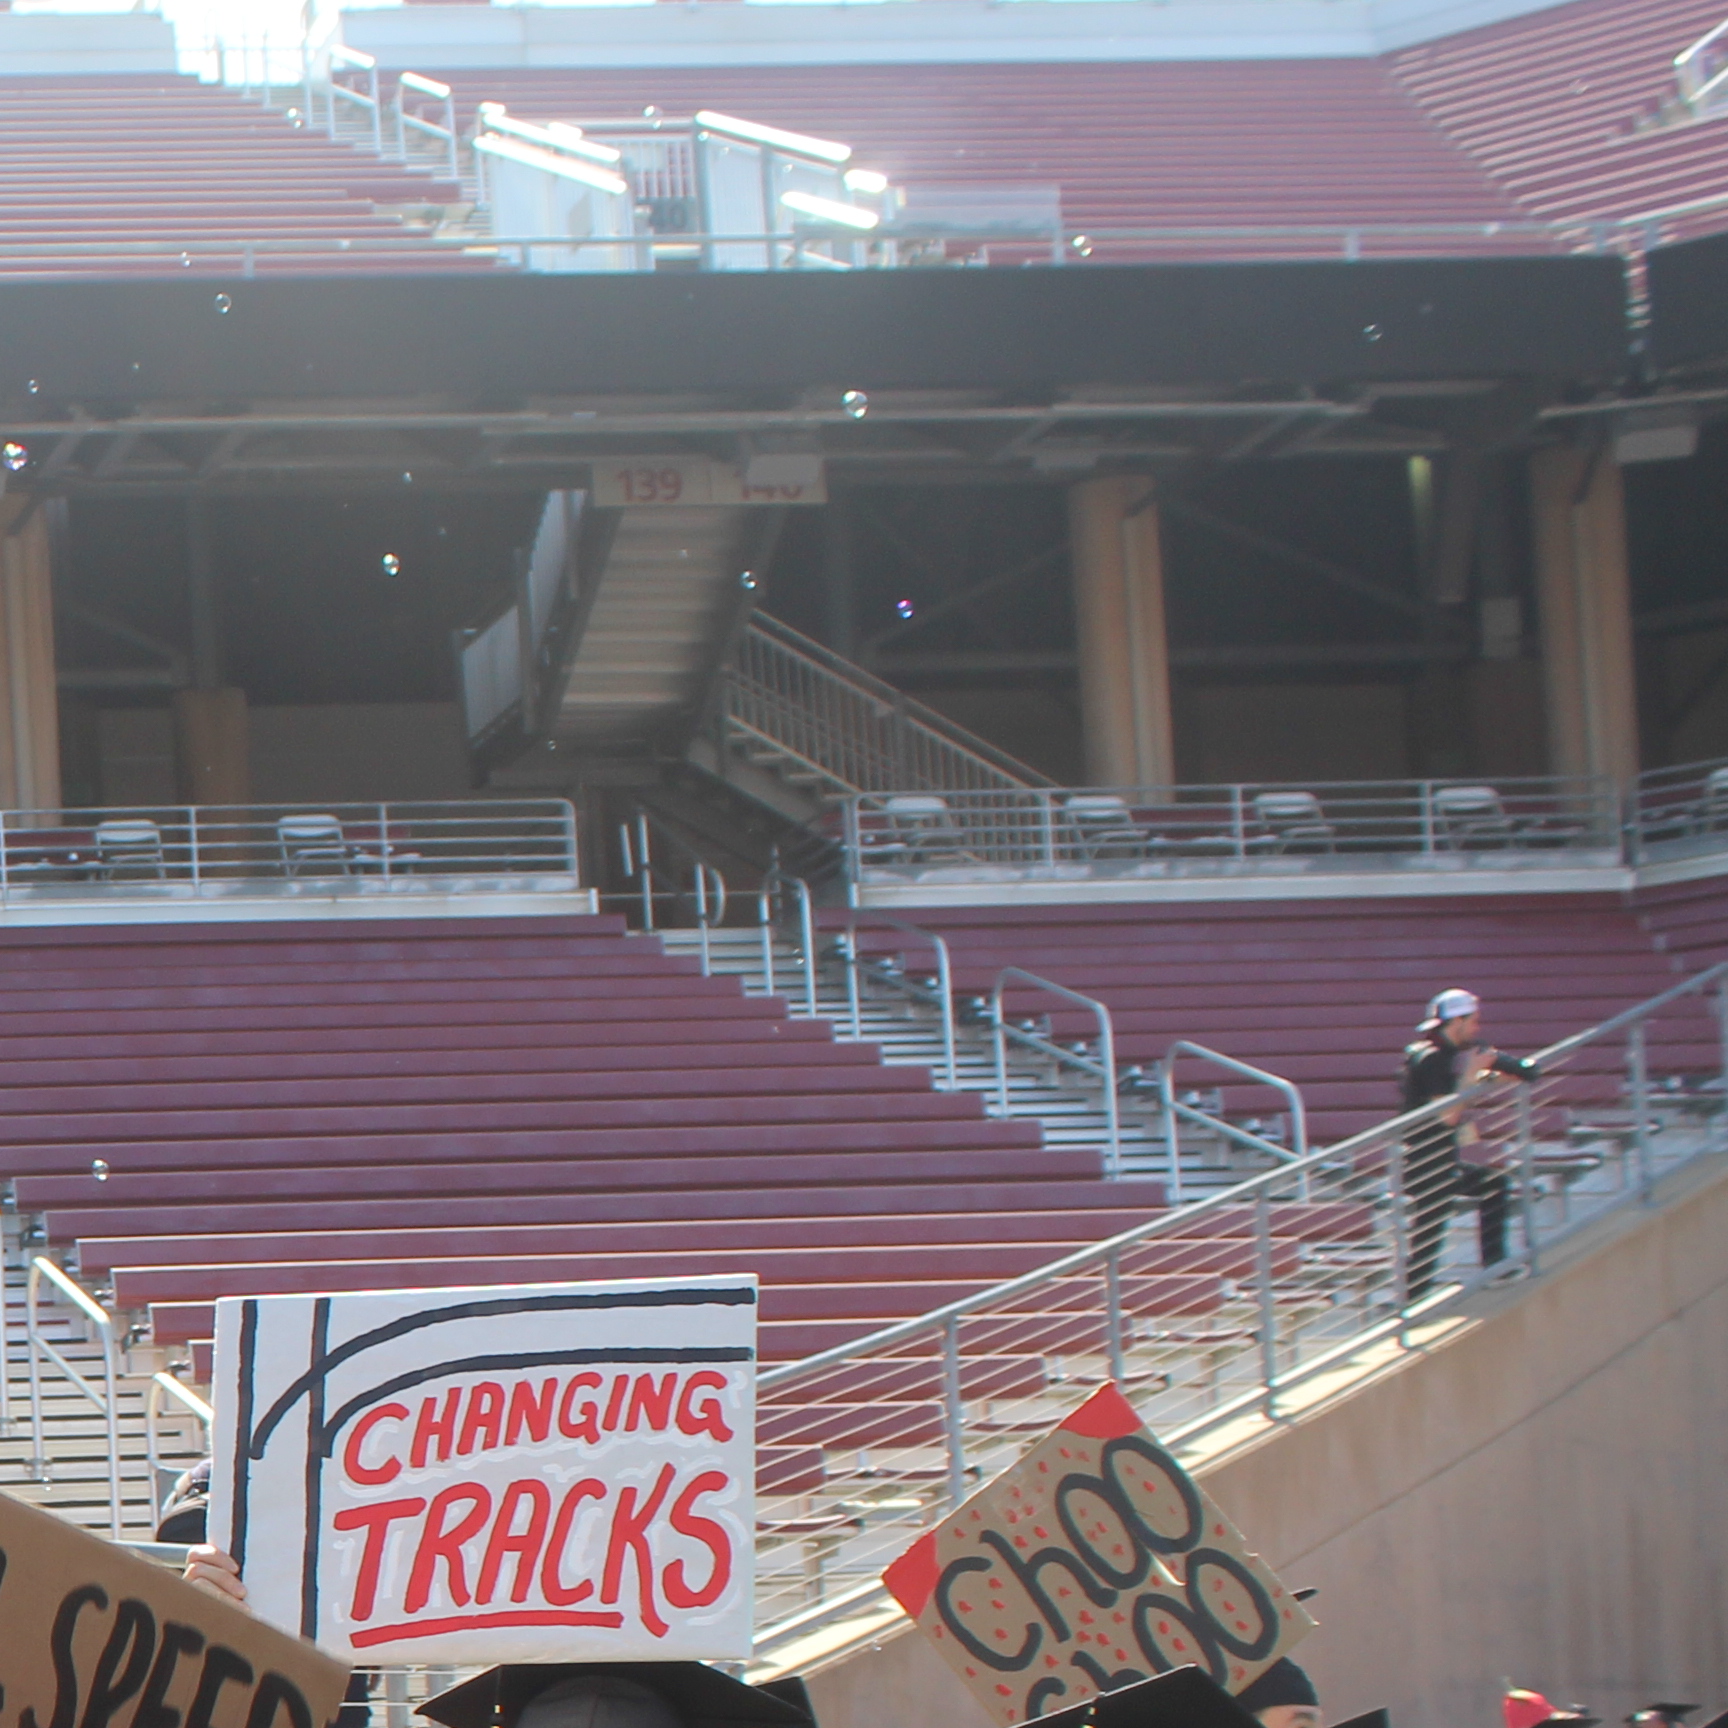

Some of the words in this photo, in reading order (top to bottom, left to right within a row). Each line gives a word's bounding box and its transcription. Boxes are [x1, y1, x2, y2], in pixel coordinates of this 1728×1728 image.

[616, 466, 682, 502] 139
[343, 1369, 734, 1486] CHANGING
[332, 1462, 732, 1638] TRACKS
